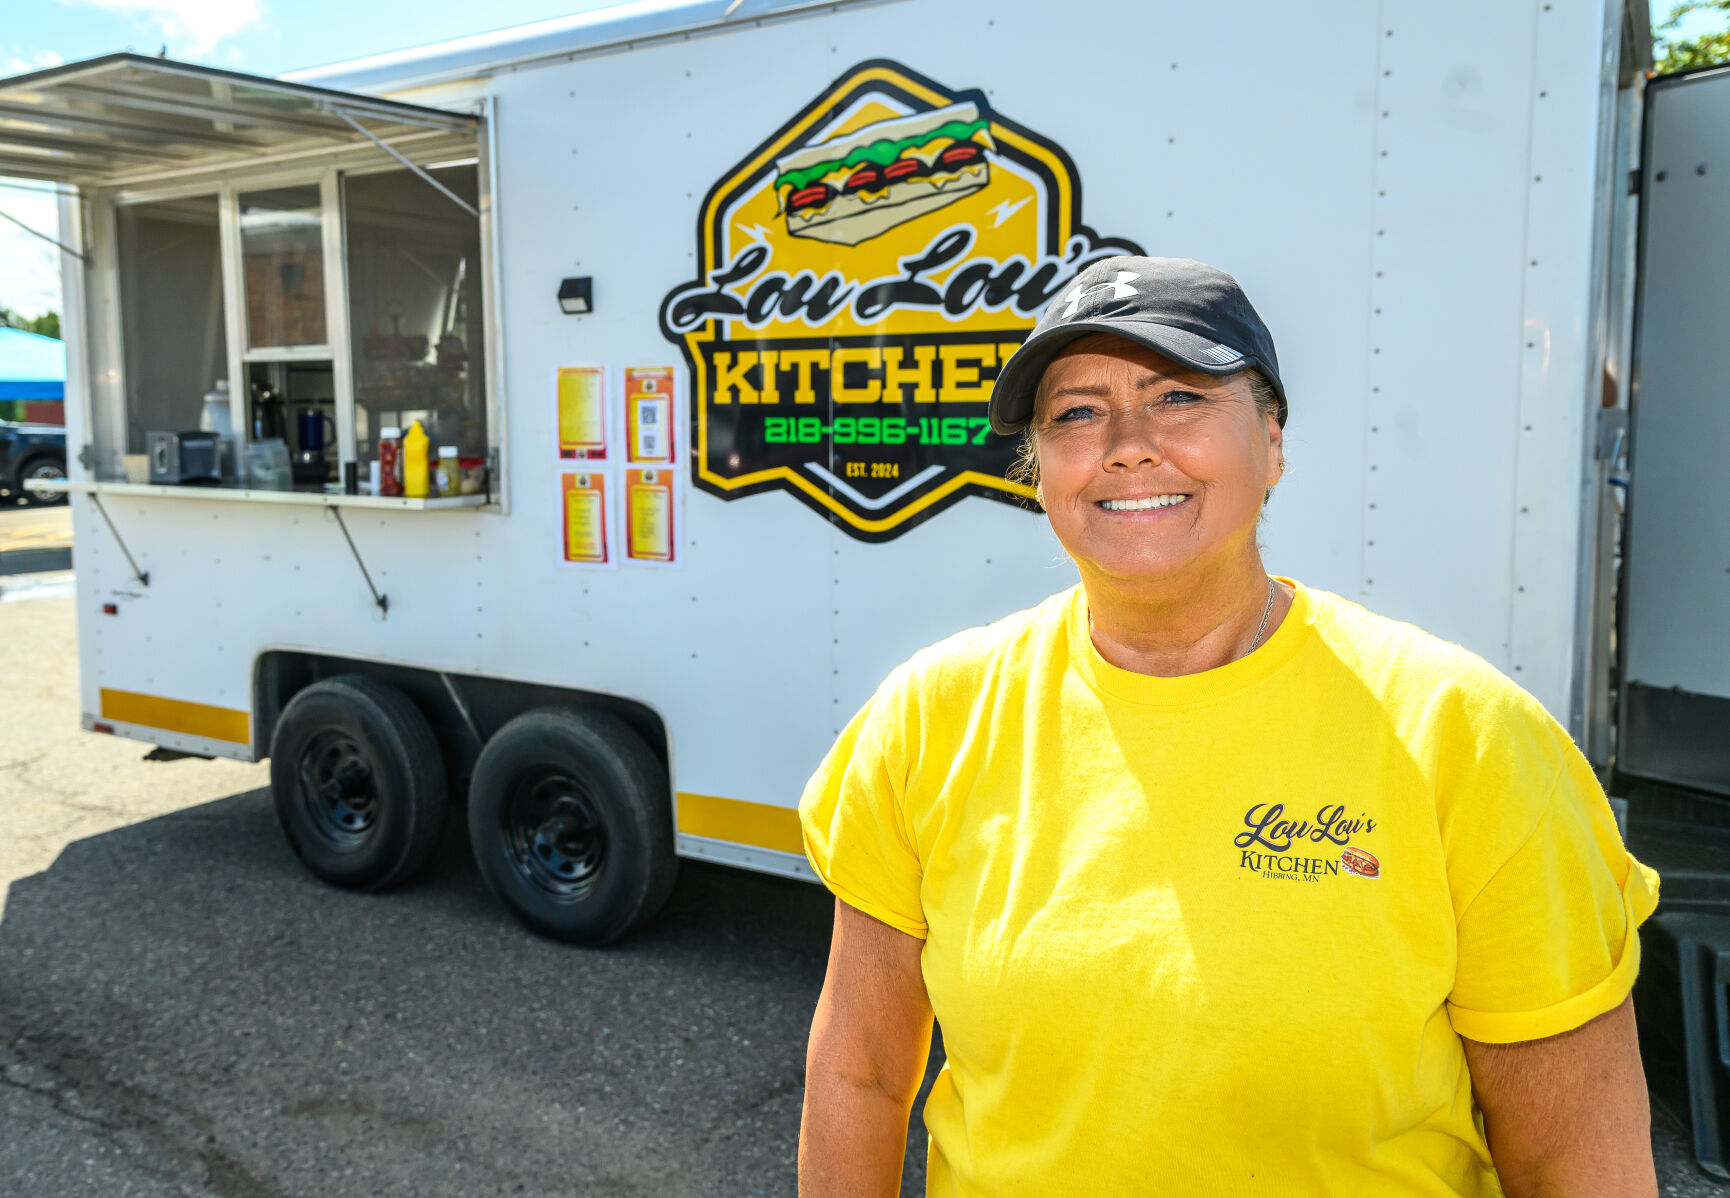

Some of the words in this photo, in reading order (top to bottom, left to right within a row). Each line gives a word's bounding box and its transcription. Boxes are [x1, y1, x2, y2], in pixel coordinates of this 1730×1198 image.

[672, 246, 851, 328] Lou
[856, 230, 1108, 321] Lou'
[713, 342, 1022, 405] KITCHE
[764, 416, 993, 446] 218-996-1167
[846, 462, 867, 479] EST.
[870, 462, 900, 479] 2024
[1234, 802, 1314, 852] Lou
[1310, 804, 1377, 846] Lou's
[1240, 850, 1340, 877] KITCHEN
[1302, 874, 1320, 883] MN
